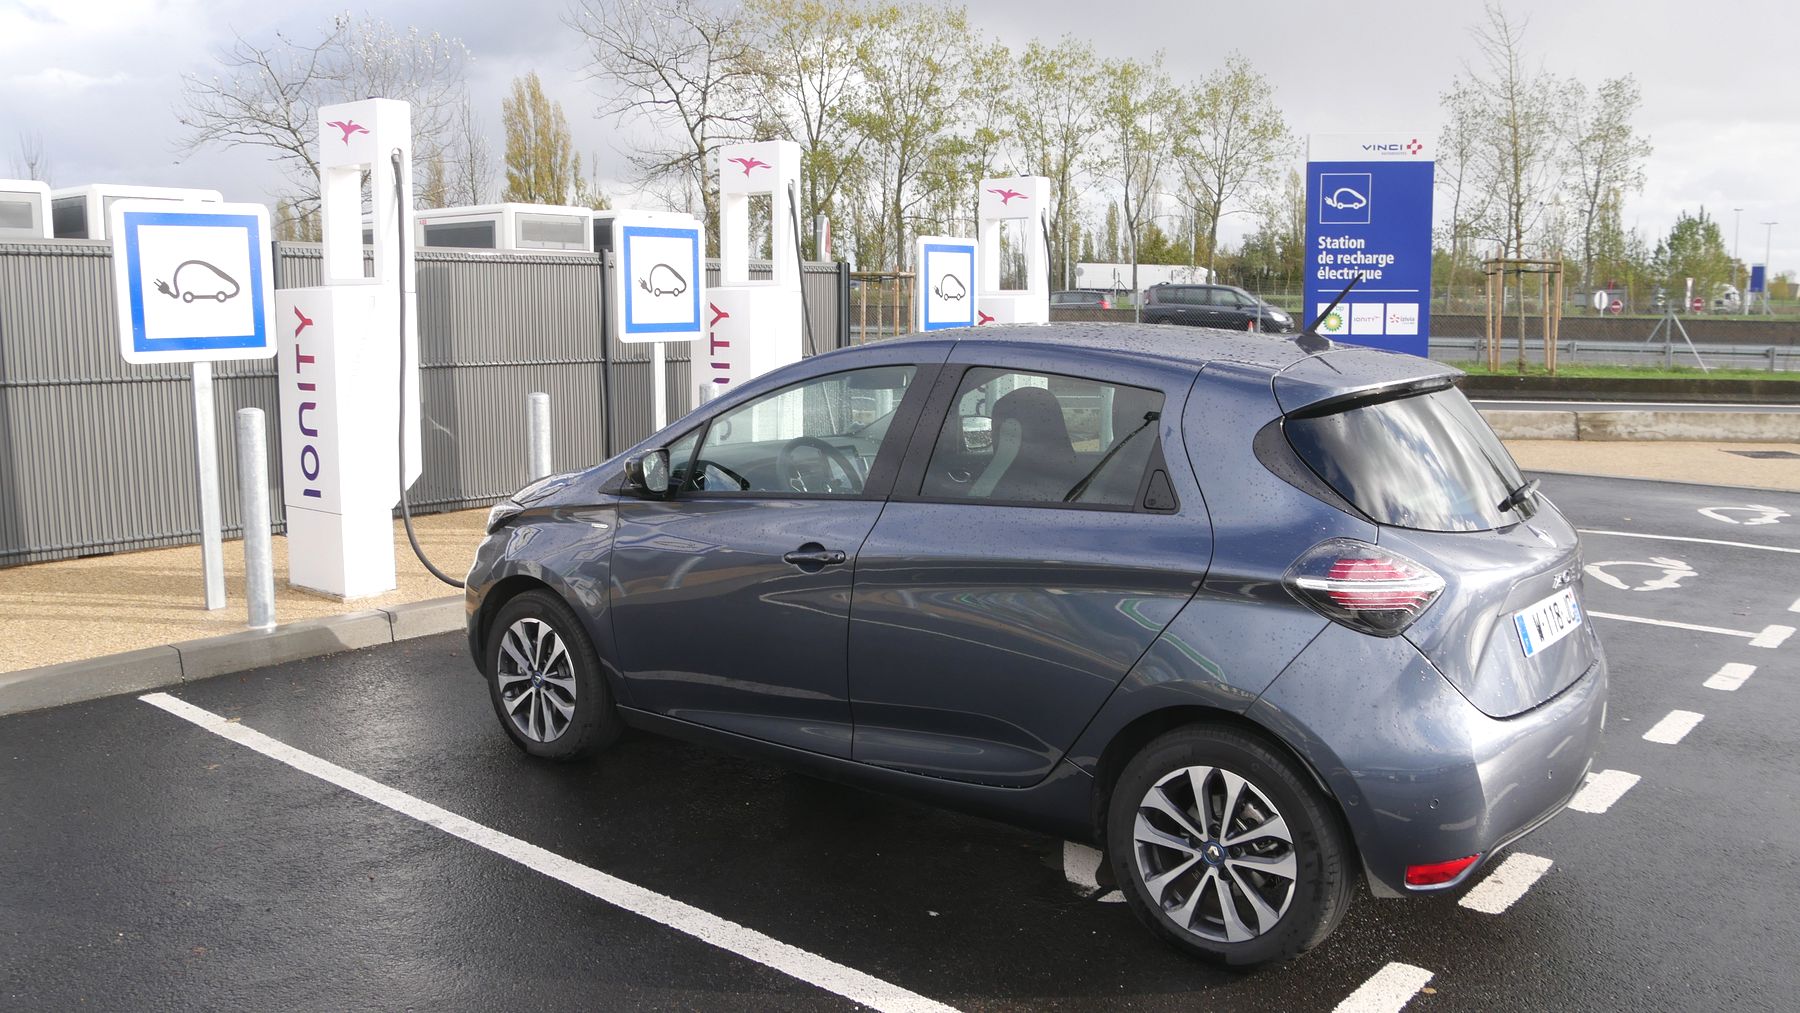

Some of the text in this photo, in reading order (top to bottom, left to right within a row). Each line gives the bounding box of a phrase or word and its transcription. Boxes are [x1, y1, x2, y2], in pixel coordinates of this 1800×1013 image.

[1318, 235, 1365, 249] Station
[1317, 251, 1395, 267] de recharge
[1317, 266, 1382, 282] électrique
[294, 305, 322, 498] IONITY
